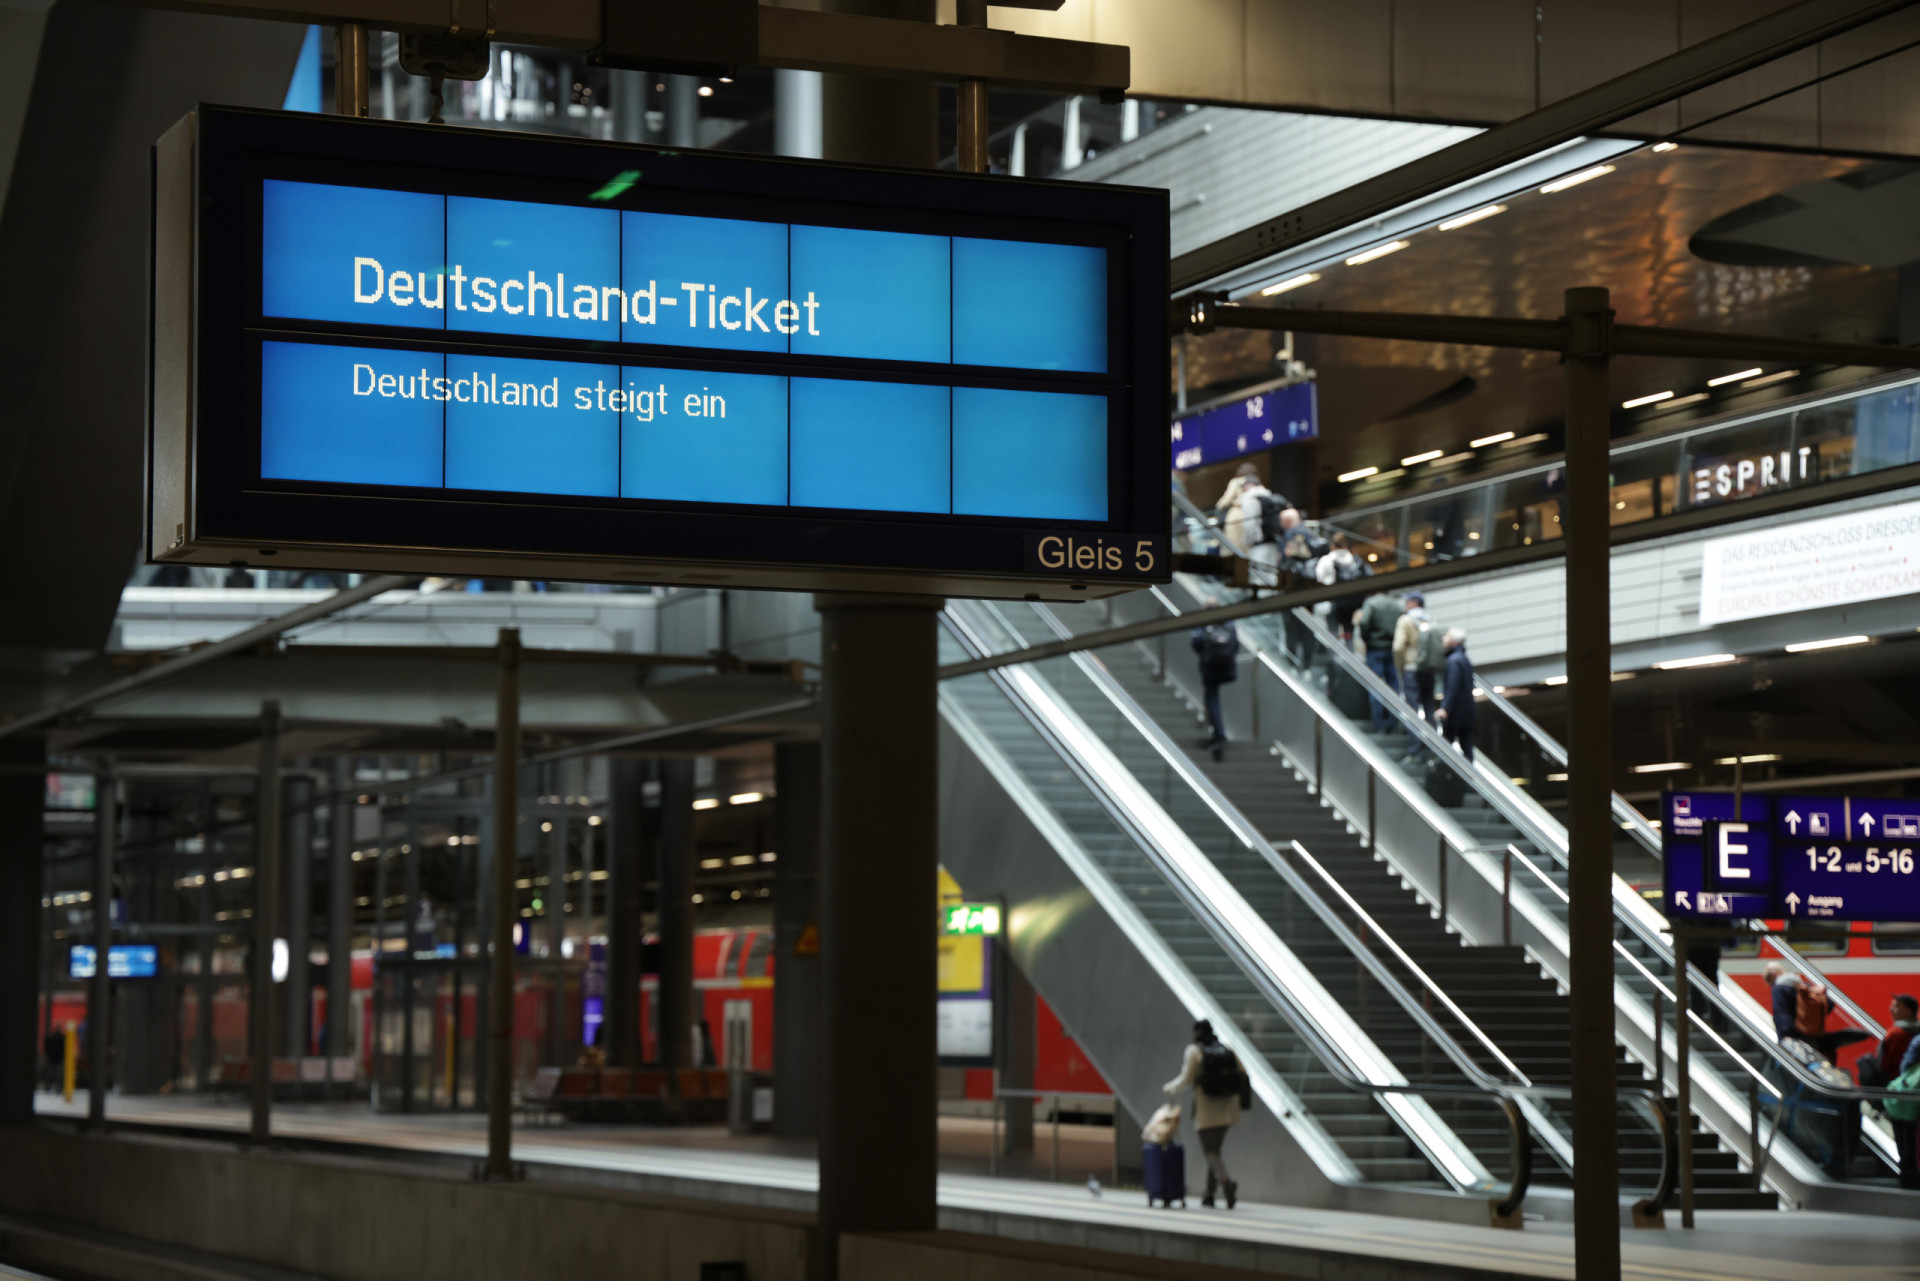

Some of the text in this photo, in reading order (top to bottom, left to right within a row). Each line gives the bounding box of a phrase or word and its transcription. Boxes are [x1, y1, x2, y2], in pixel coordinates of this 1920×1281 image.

[353, 255, 820, 337] Deutschland-Ticket
[353, 363, 727, 422] Deutschland steigt ein
[1694, 446, 1812, 501] ESPRIT
[1037, 535, 1155, 573] Gleis 5
[1719, 823, 1751, 879] E
[1806, 845, 1842, 873] 1-2
[1865, 847, 1915, 875] 5-16
